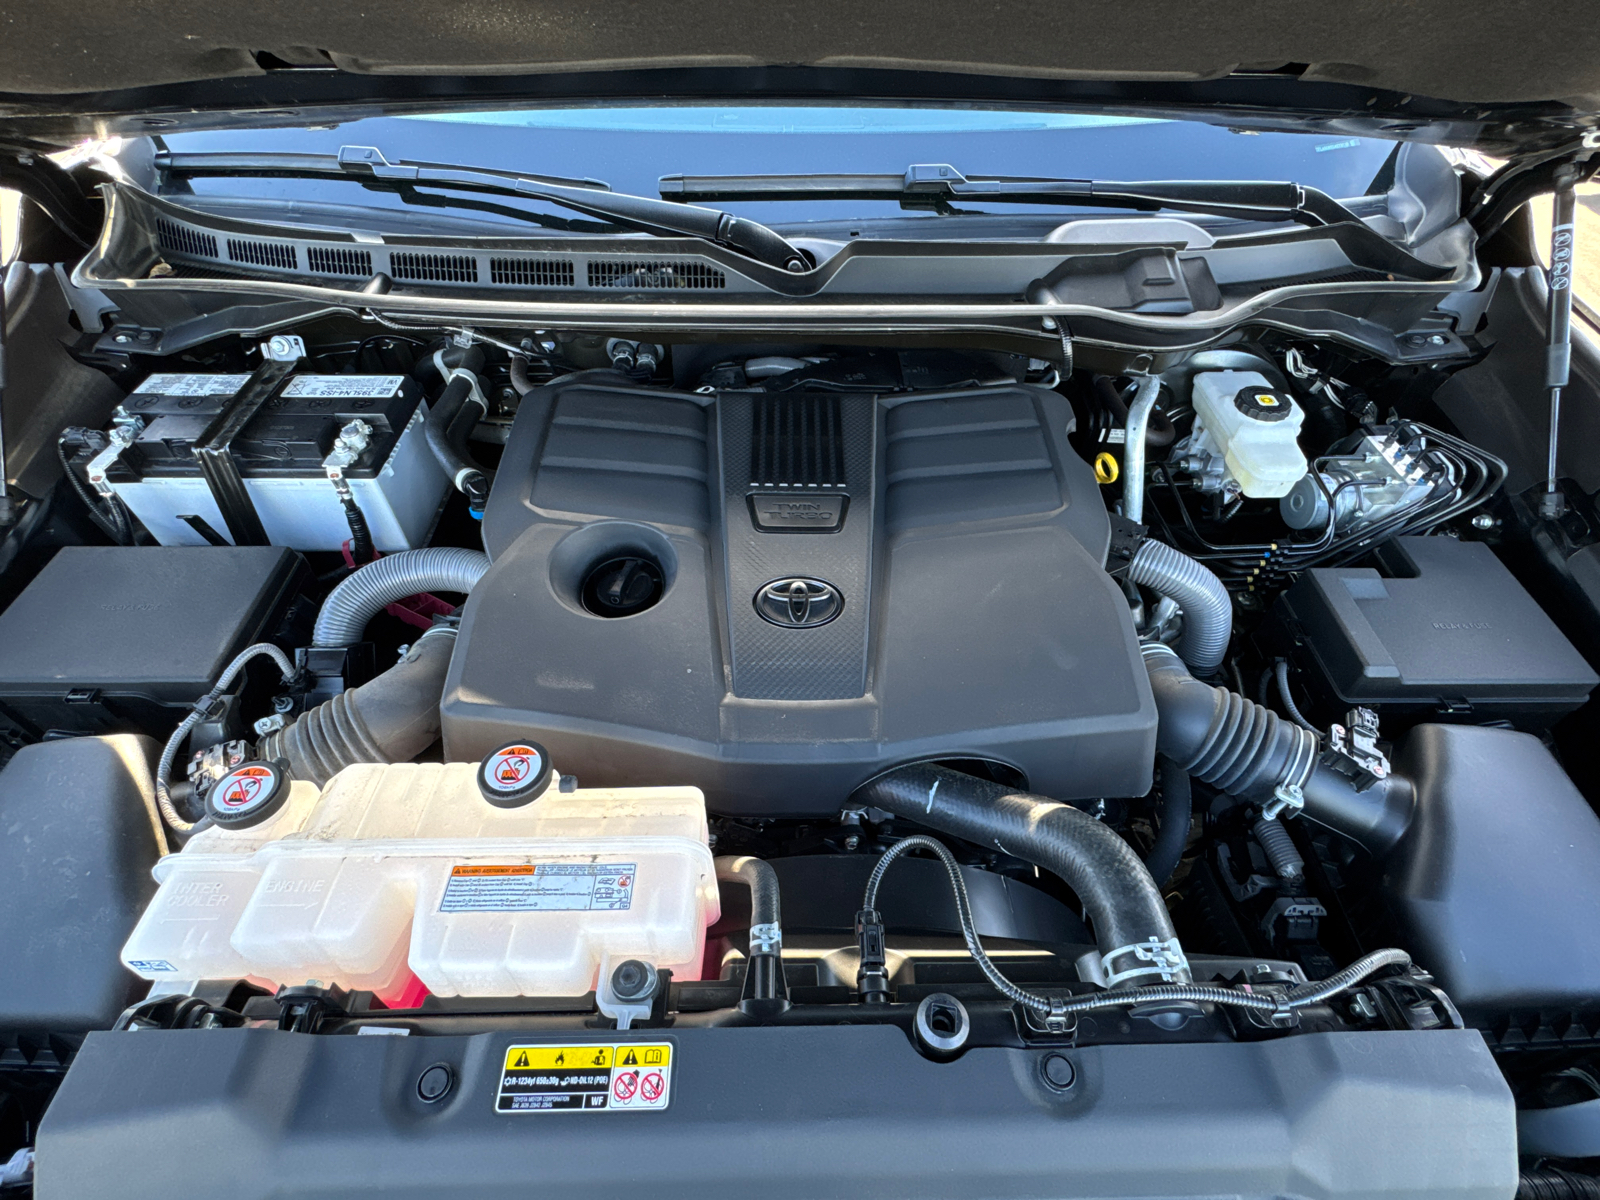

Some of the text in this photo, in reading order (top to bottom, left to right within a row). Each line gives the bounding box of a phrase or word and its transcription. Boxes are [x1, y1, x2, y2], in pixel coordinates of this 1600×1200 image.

[772, 502, 820, 511] TWIN
[763, 511, 833, 520] TURBO
[1432, 622, 1460, 630] RELAY
[172, 882, 224, 895] INTER
[264, 879, 325, 893] ENGINE
[167, 895, 230, 907] COOLER
[510, 1076, 536, 1087] R-1234yf
[593, 1076, 609, 1086] (POE)
[591, 1096, 604, 1106] WF
